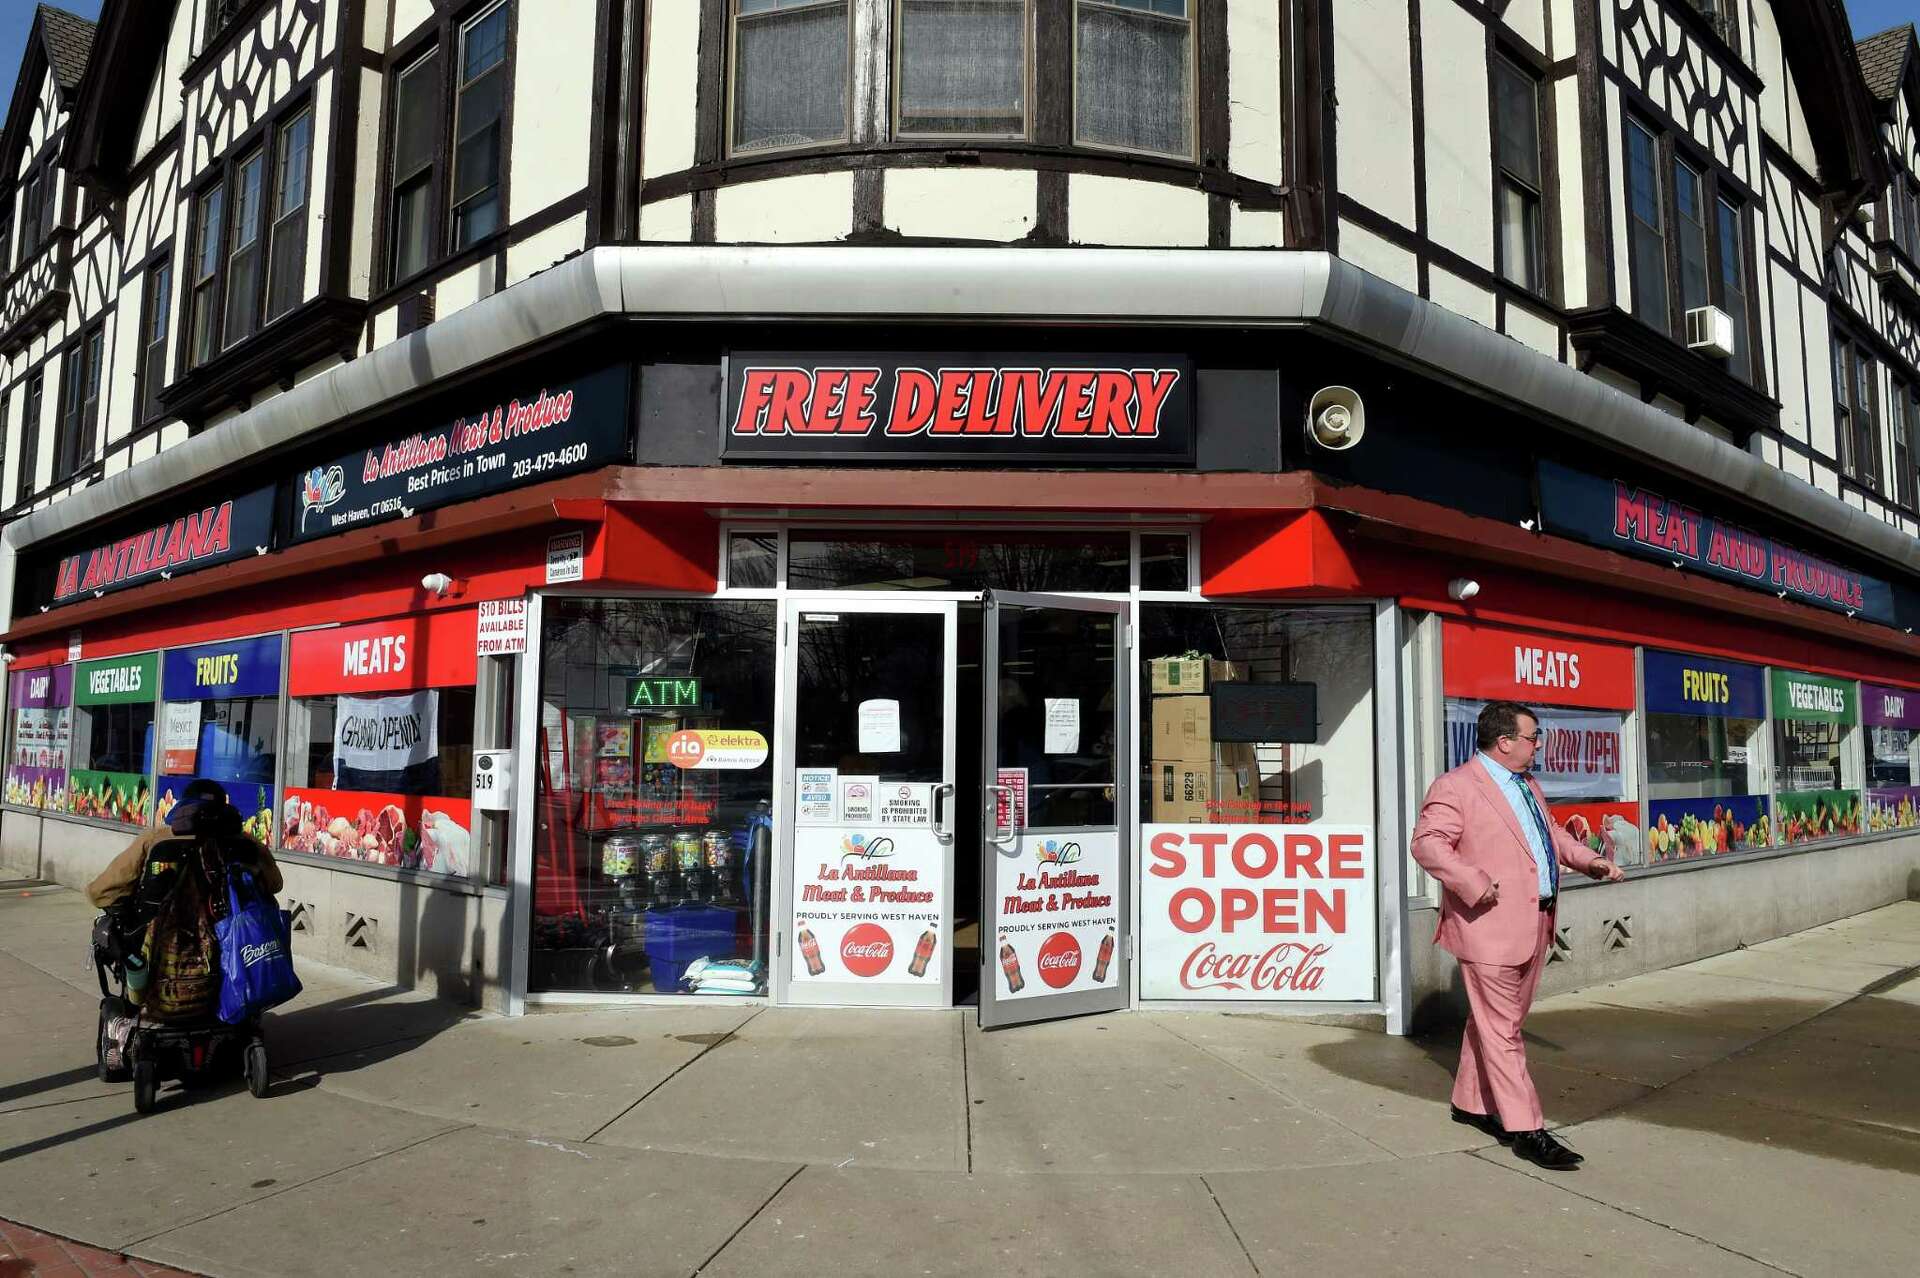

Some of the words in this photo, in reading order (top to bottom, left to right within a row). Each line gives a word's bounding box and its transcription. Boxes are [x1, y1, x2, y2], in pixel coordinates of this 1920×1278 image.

[732, 367, 882, 437] FREE
[885, 367, 1180, 438] DELIVERY
[362, 448, 379, 484] La
[380, 431, 447, 482] Antillana
[448, 412, 489, 455] Meat
[488, 405, 502, 445] &
[504, 388, 573, 441] Produce
[407, 474, 429, 493] Best
[431, 465, 461, 489] Prices
[463, 460, 474, 476] in
[476, 452, 506, 473] Town
[512, 442, 588, 479] 203-479-4600
[331, 511, 347, 527] West
[347, 507, 370, 522] Haven,
[371, 503, 380, 516] CT
[381, 496, 402, 514] 06516
[54, 555, 80, 600] LA
[79, 500, 233, 592] ANTILLANA
[1613, 478, 1702, 560] MEAT
[1706, 516, 1766, 579] AND
[1770, 537, 1863, 611] PRODUCE
[498, 600, 524, 615] BILLS
[479, 618, 524, 633] AVAILABLE
[343, 635, 406, 677] MEATS
[478, 639, 502, 652] FROM
[504, 637, 525, 651] ATM
[89, 666, 142, 694] VEGETABLES
[196, 653, 239, 686] FRUITS
[1514, 646, 1581, 689] MEATS
[30, 676, 51, 699] DAIRY
[634, 681, 696, 704] ATM
[1683, 669, 1729, 703] FRUITS
[1788, 681, 1845, 712] VEGETABLES
[1884, 695, 1905, 718] DAIRY
[672, 735, 700, 754] ria
[720, 734, 760, 746] elektra
[1544, 728, 1581, 773] NOW
[1585, 731, 1620, 774] OPEN
[476, 774, 493, 789] 519
[1184, 772, 1194, 801] 66229
[913, 815, 927, 823] LAW
[1149, 832, 1364, 879] STORE
[817, 863, 839, 881] La
[841, 863, 918, 881] Antillana
[1017, 873, 1036, 890] La
[1038, 870, 1099, 890] Antillana
[802, 884, 848, 902] Meat
[850, 886, 866, 903] &
[869, 886, 934, 903] Produce
[1003, 896, 1044, 915] Meat
[1046, 894, 1059, 912] &
[1062, 891, 1111, 911] Produce
[796, 912, 838, 920] PROUDLY
[840, 912, 879, 921] SERVING
[881, 913, 906, 921] WEST
[908, 913, 939, 921] HAVEN
[1168, 887, 1346, 933] OPEN
[998, 924, 1035, 933] PROUDLY
[1037, 921, 1070, 931] SERVING
[1072, 919, 1091, 928] WEST
[1092, 917, 1116, 926] HAVEN
[1179, 942, 1333, 991] Coca-Cola
